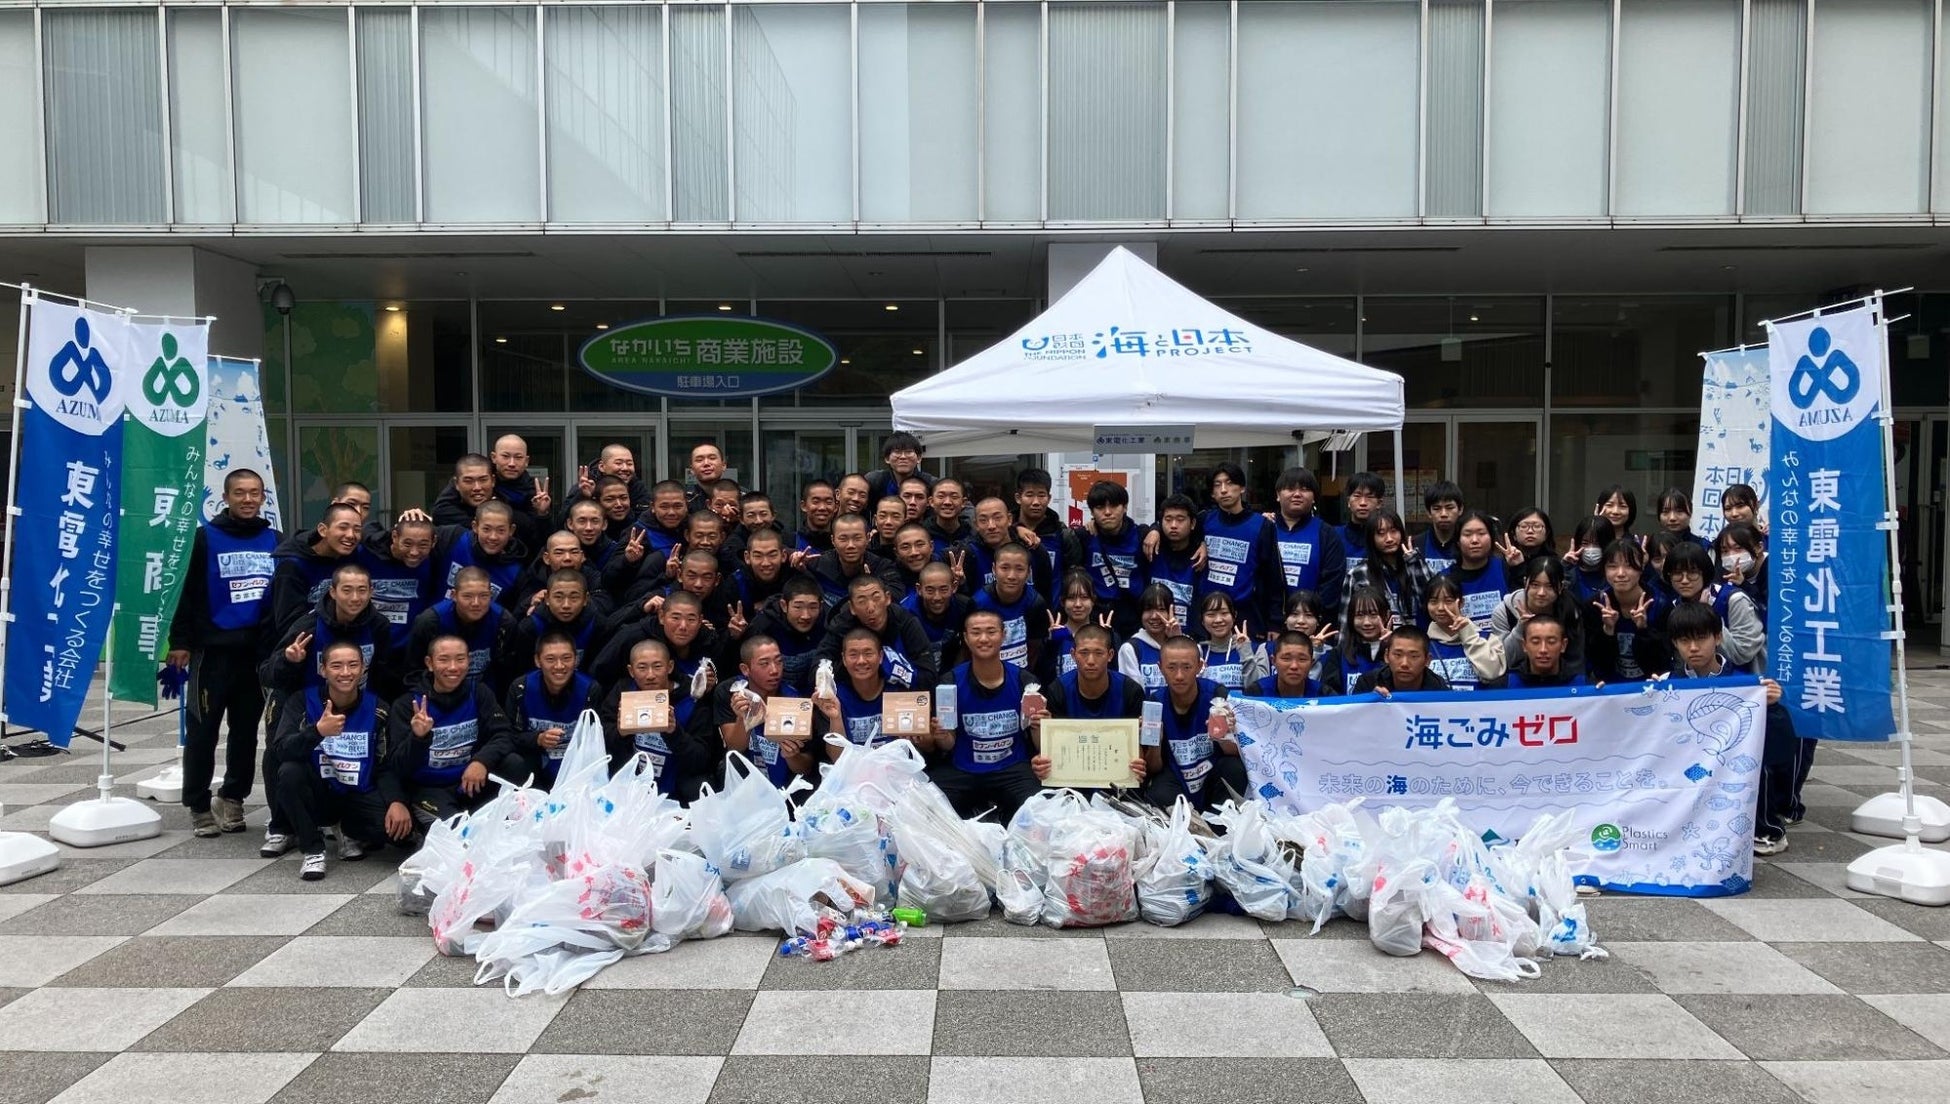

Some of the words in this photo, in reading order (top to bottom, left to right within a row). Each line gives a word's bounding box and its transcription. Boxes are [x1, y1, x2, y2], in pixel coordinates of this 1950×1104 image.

[1092, 326, 1250, 359] 海と日本
[1156, 346, 1252, 356] PROJECT
[610, 339, 691, 355] なかいち
[696, 338, 804, 365] 商業施設
[677, 375, 739, 388] 駐車場入口
[56, 398, 102, 423] AZUM
[150, 408, 189, 425] AZUMA
[1405, 714, 1579, 751] 海ごみゼロ
[1622, 825, 1668, 841] Plastics
[1621, 840, 1658, 851] Smart
